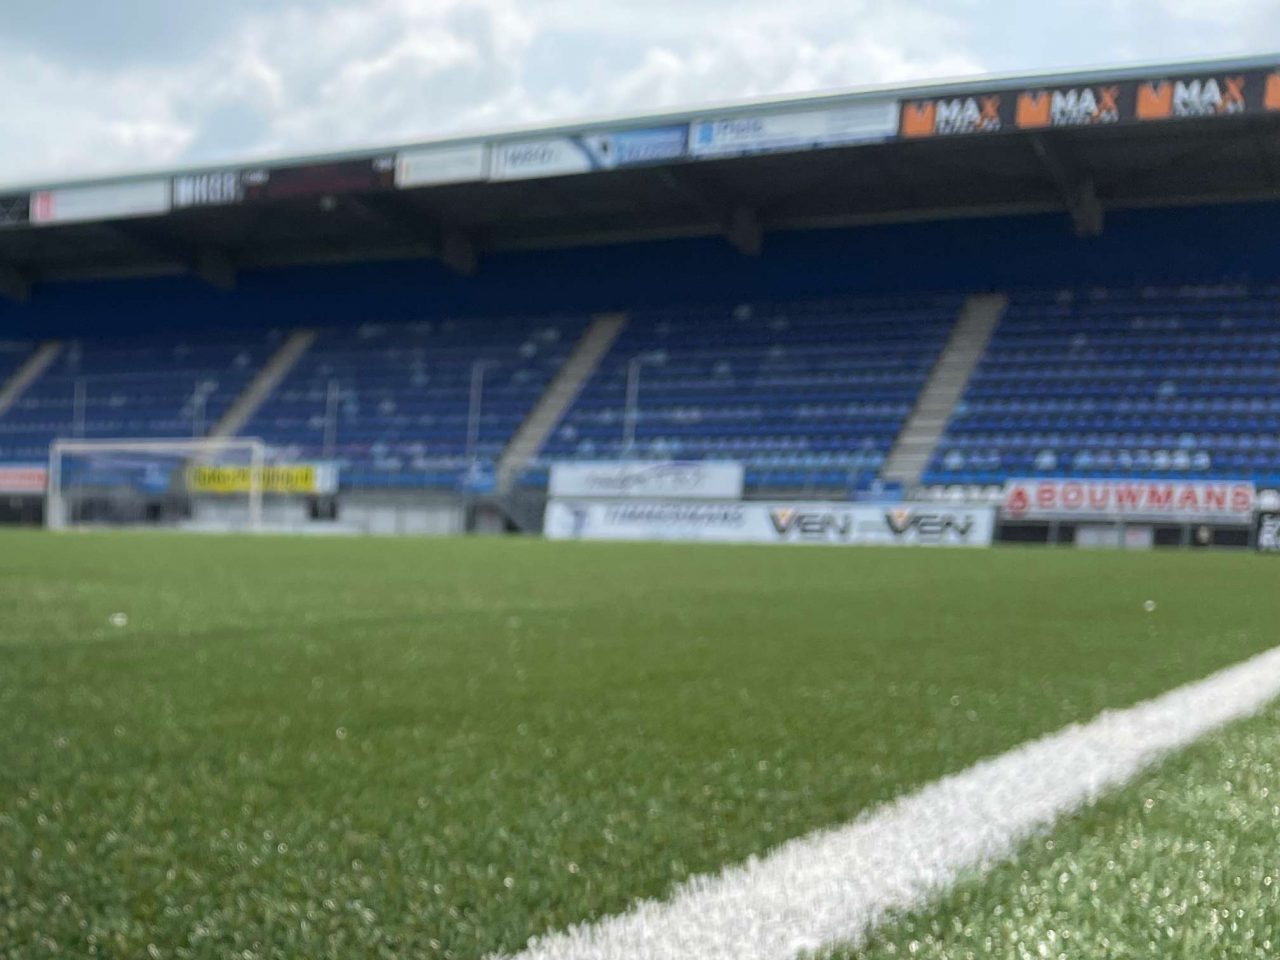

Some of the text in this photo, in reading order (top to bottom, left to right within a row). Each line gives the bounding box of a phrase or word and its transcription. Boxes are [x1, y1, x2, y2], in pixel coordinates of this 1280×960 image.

[1052, 87, 1118, 121] MAX
[1174, 77, 1245, 112] MAX
[936, 96, 1000, 127] MAX
[1036, 482, 1252, 515] BOUWMANS
